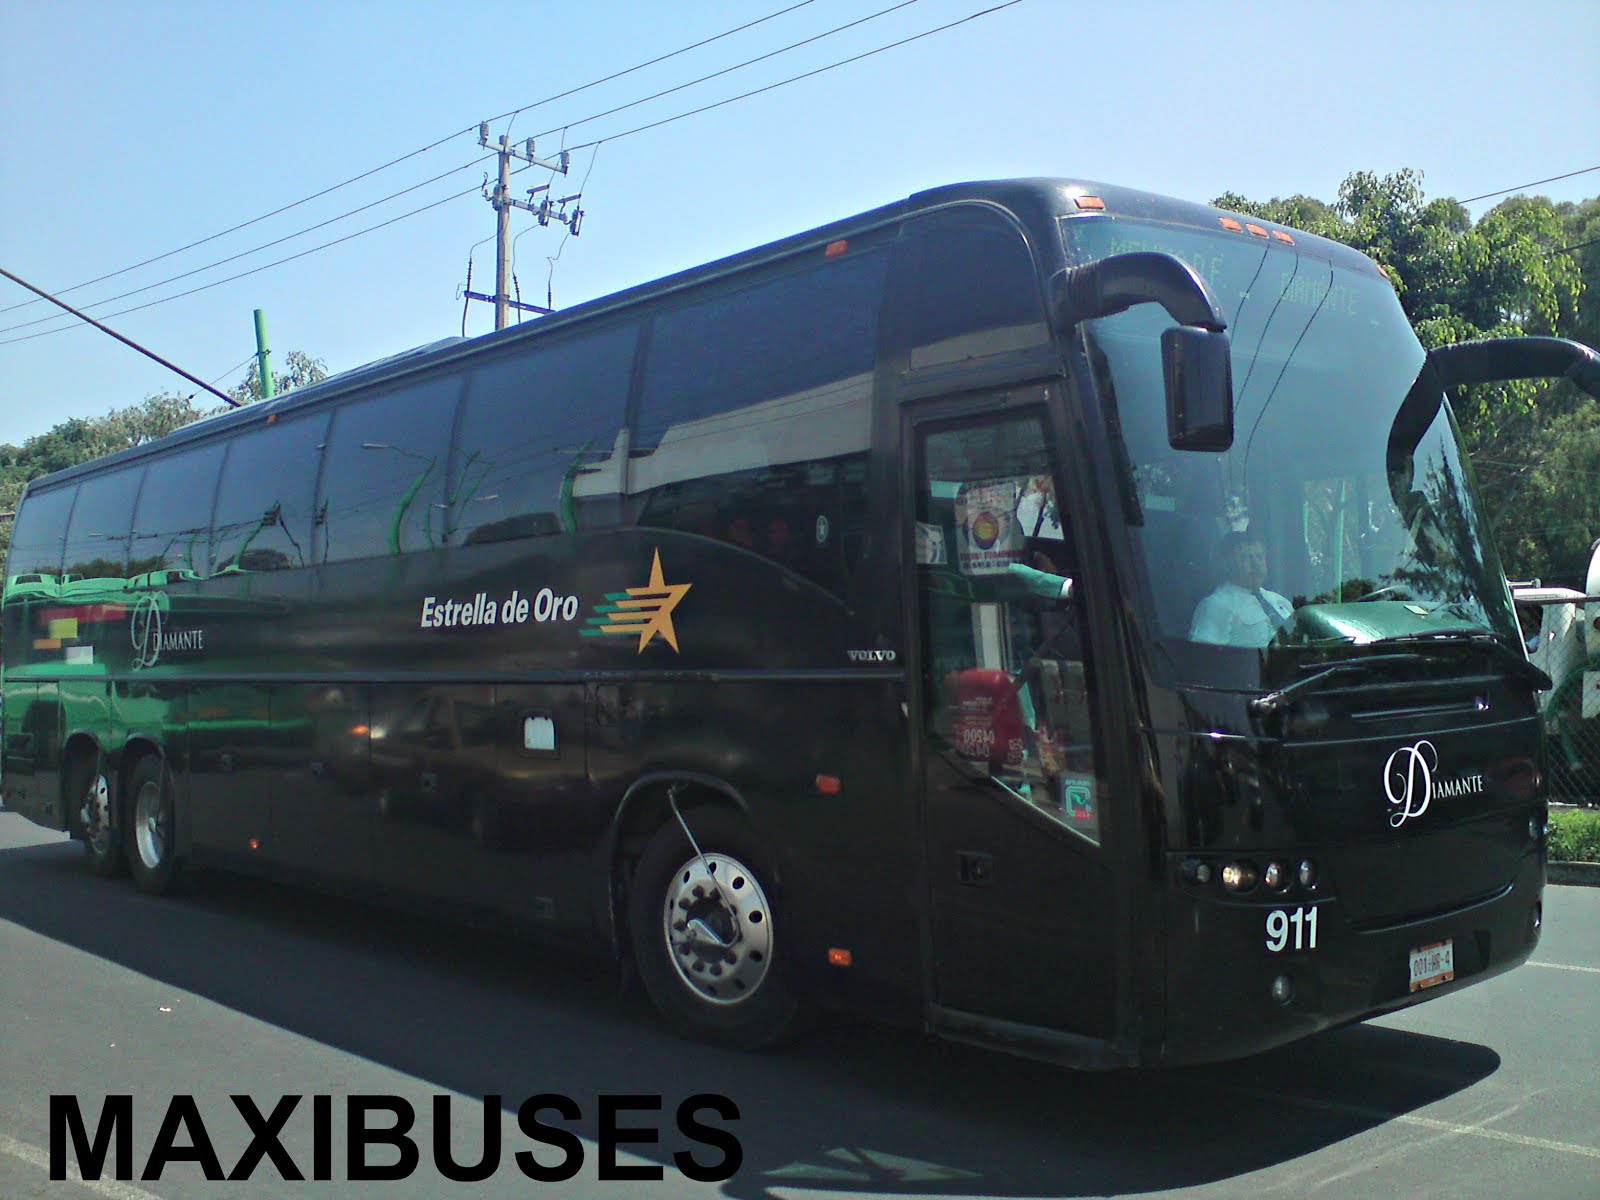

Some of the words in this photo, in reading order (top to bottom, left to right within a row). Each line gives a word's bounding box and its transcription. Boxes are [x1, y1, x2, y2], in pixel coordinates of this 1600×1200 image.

[420, 593, 498, 628] Estrella
[501, 590, 529, 624] de
[533, 588, 579, 622] Oro
[846, 649, 897, 662] VOLVO
[1383, 740, 1484, 829] DIAMANTE
[1265, 906, 1318, 952] 911
